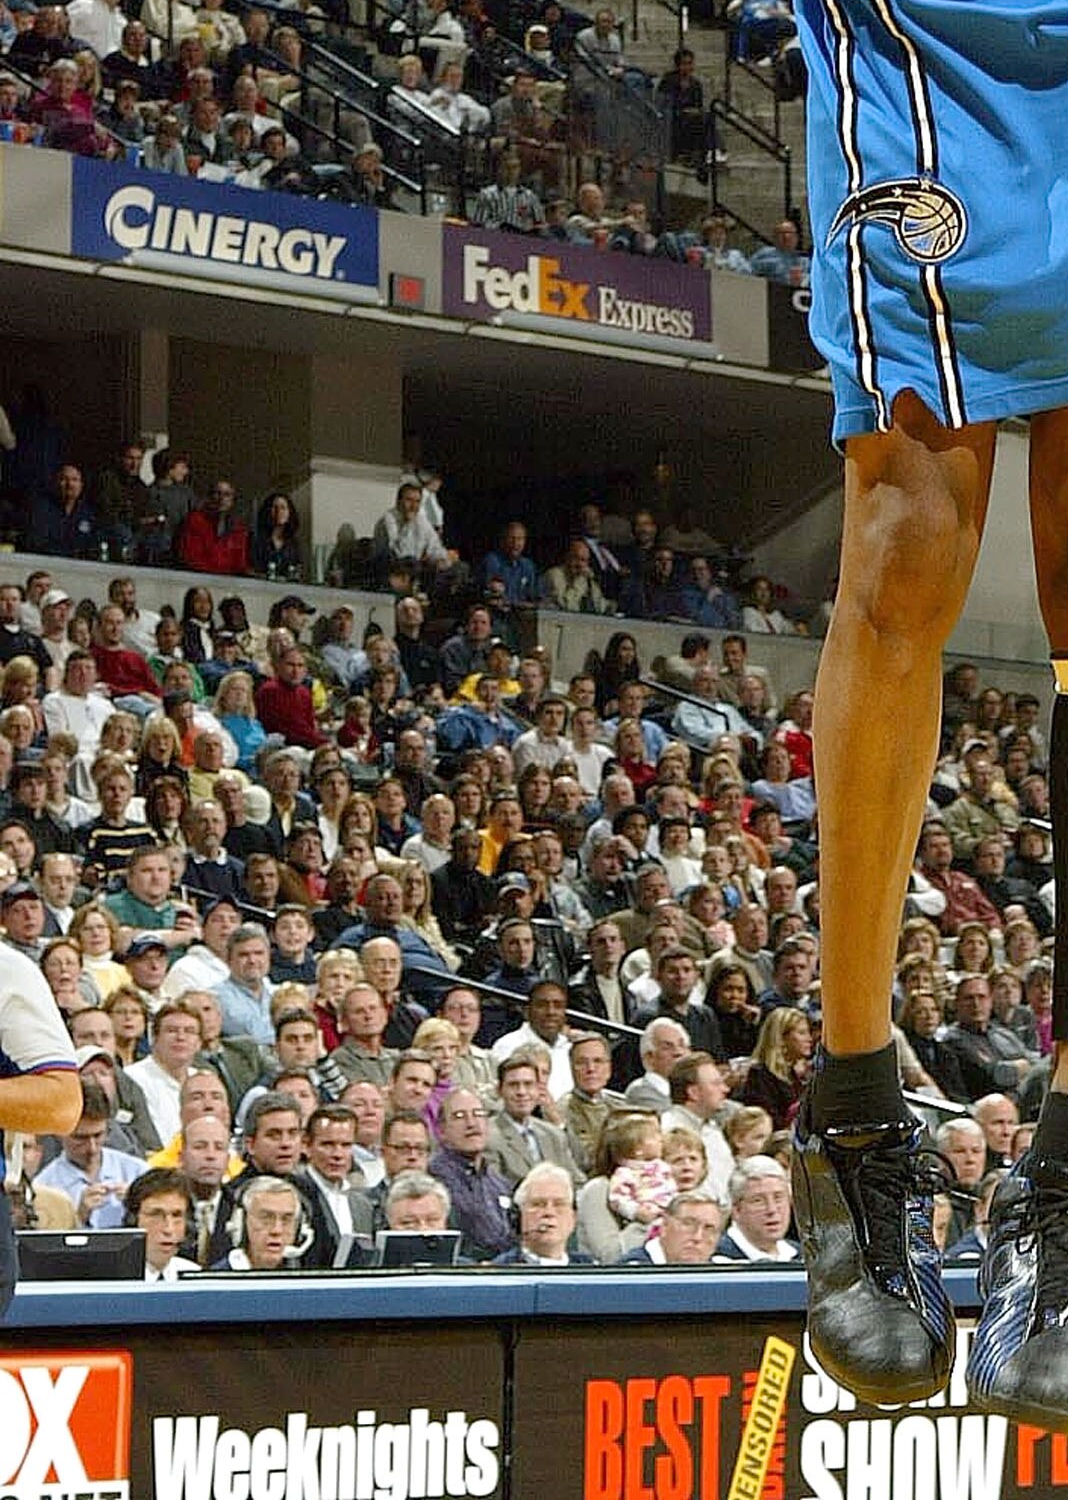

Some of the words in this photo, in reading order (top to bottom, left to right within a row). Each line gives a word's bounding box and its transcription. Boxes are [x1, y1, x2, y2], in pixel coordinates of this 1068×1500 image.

[105, 185, 347, 279] CINERGY
[463, 244, 591, 320] FedEx
[598, 286, 695, 338] Express
[154, 1409, 499, 1500] Weeknights
[585, 1375, 731, 1500] BEST
[732, 1347, 788, 1500] ENSORED
[801, 1415, 1009, 1500] SHOW
